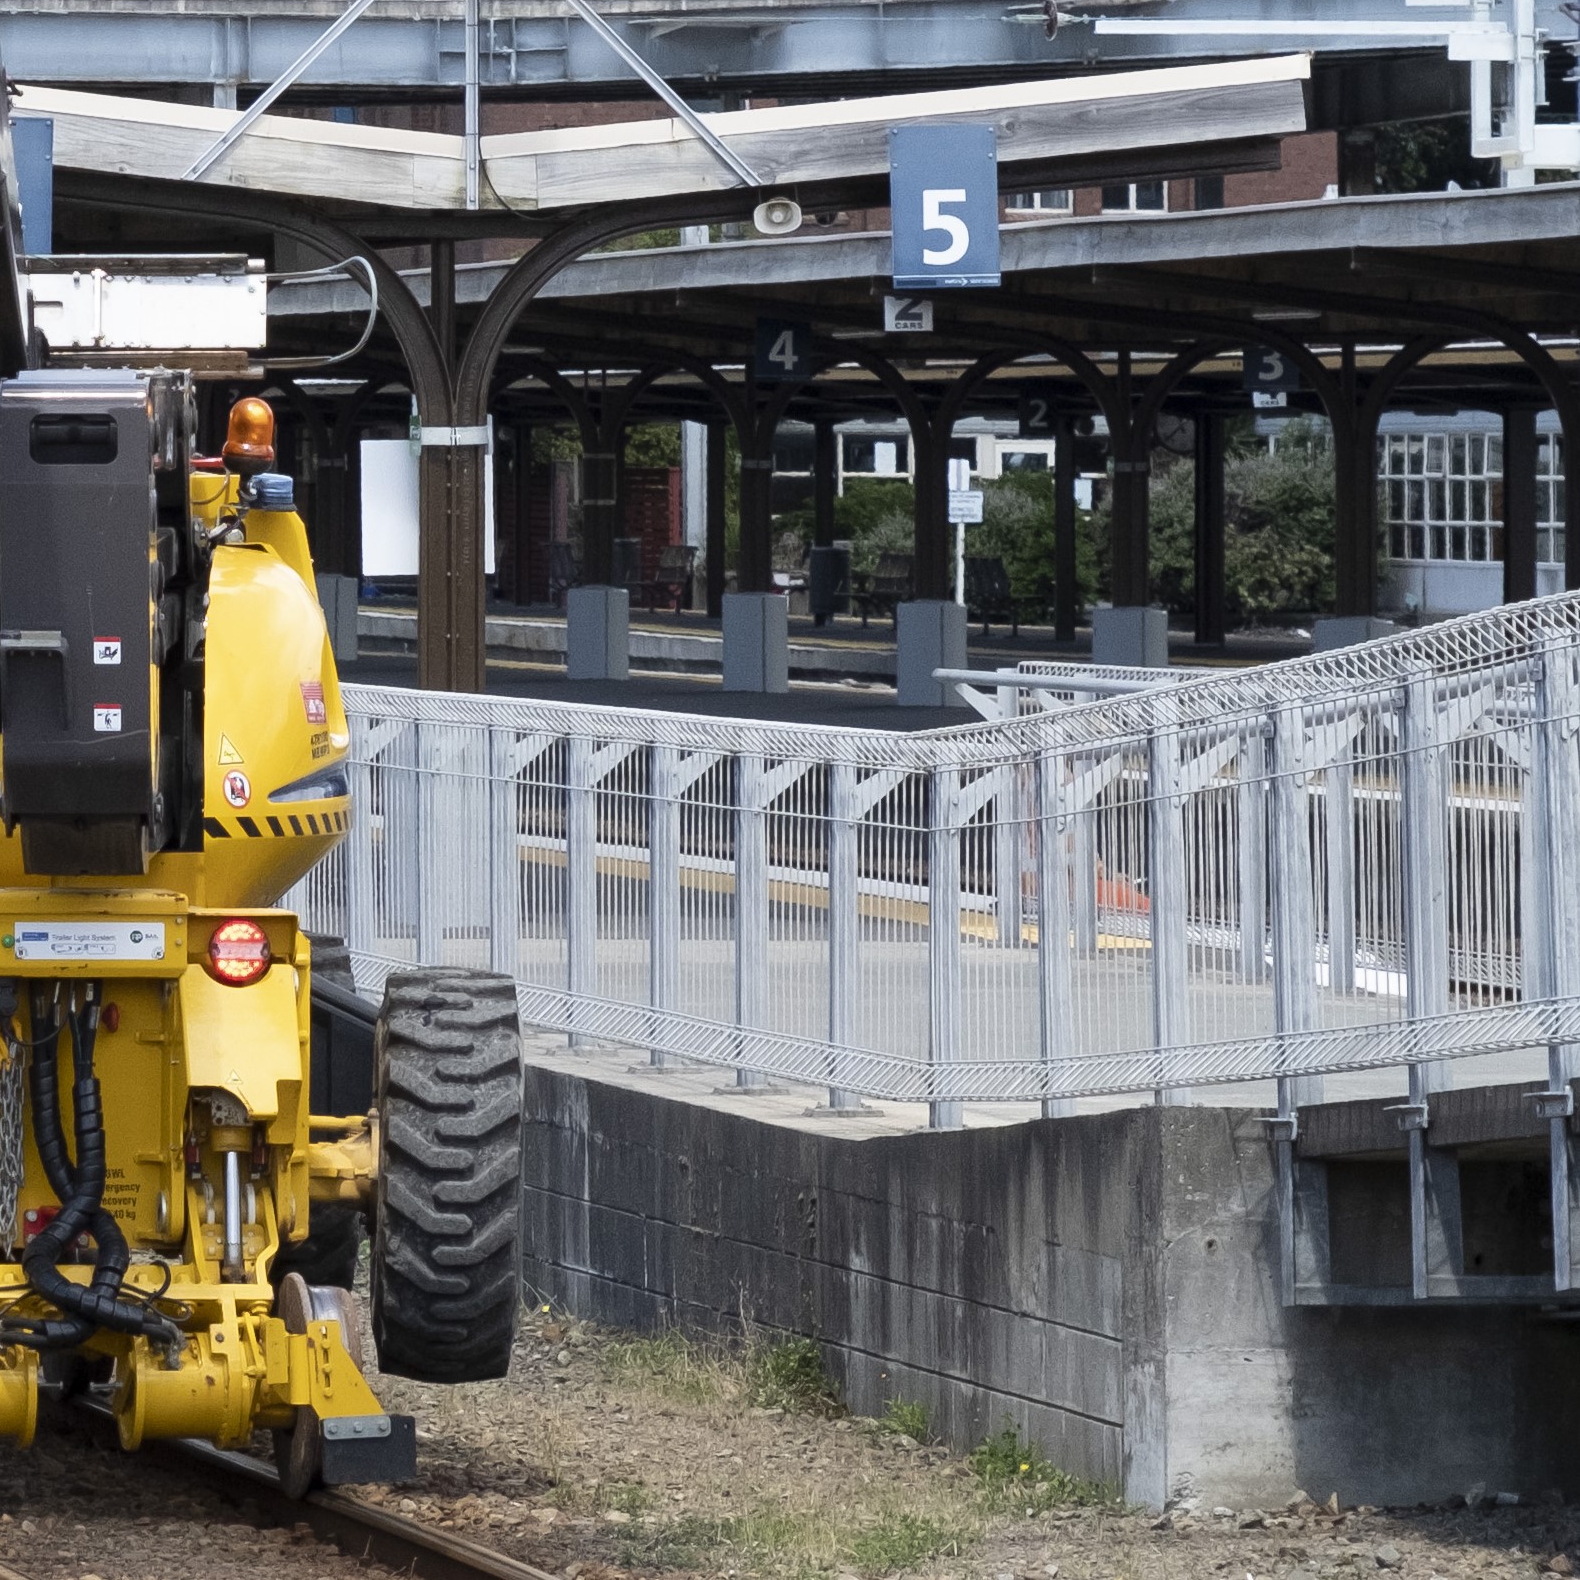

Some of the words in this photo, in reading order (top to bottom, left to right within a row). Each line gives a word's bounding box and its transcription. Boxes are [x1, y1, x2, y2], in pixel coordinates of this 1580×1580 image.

[923, 189, 969, 265] 5
[895, 297, 923, 321] 2
[769, 330, 798, 370] 4
[1028, 399, 1048, 427] 2
[106, 1184, 140, 1194] ergency
[102, 1197, 137, 1207] ecovery
[126, 1210, 136, 1220] kg
